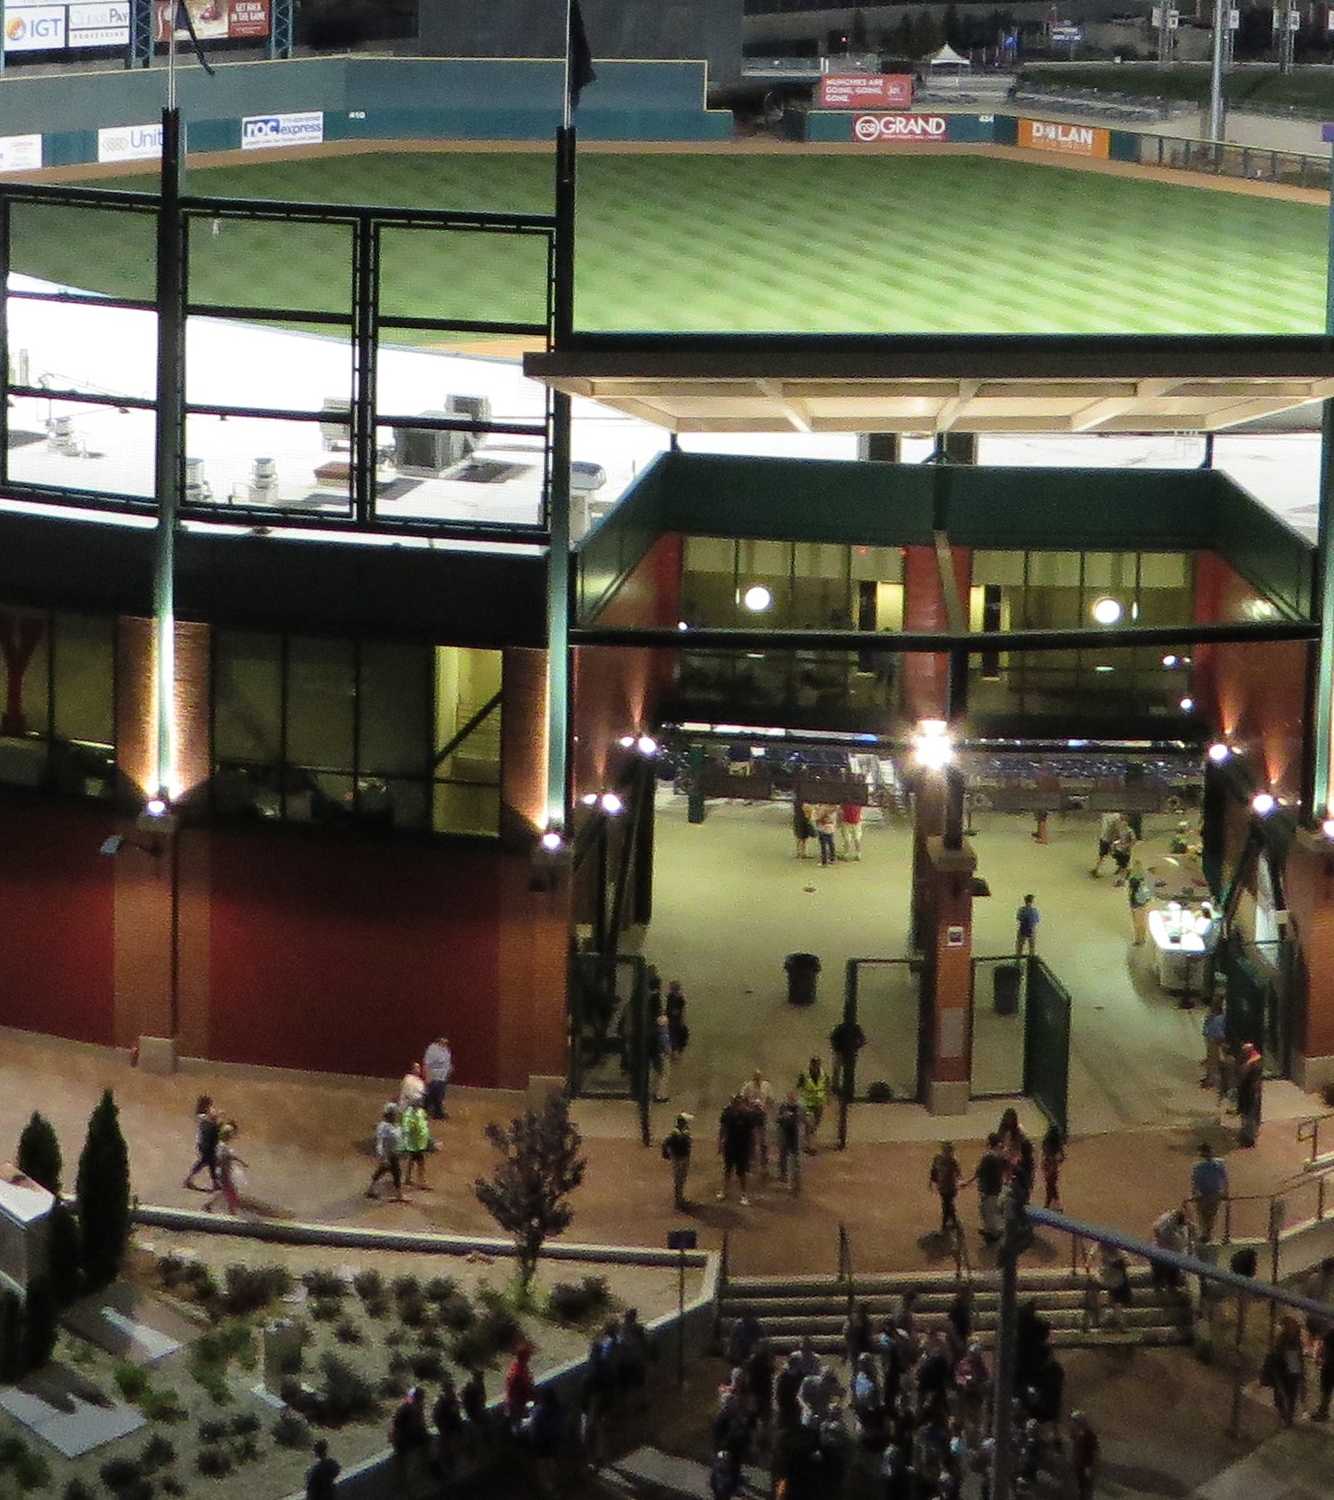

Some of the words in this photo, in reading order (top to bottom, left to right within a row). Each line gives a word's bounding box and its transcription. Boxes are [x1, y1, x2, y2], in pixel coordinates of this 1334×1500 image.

[30, 18, 62, 38] IGT
[349, 111, 365, 119] 410
[279, 123, 321, 136] express
[880, 116, 946, 134] GRAND
[131, 129, 163, 149] Unit
